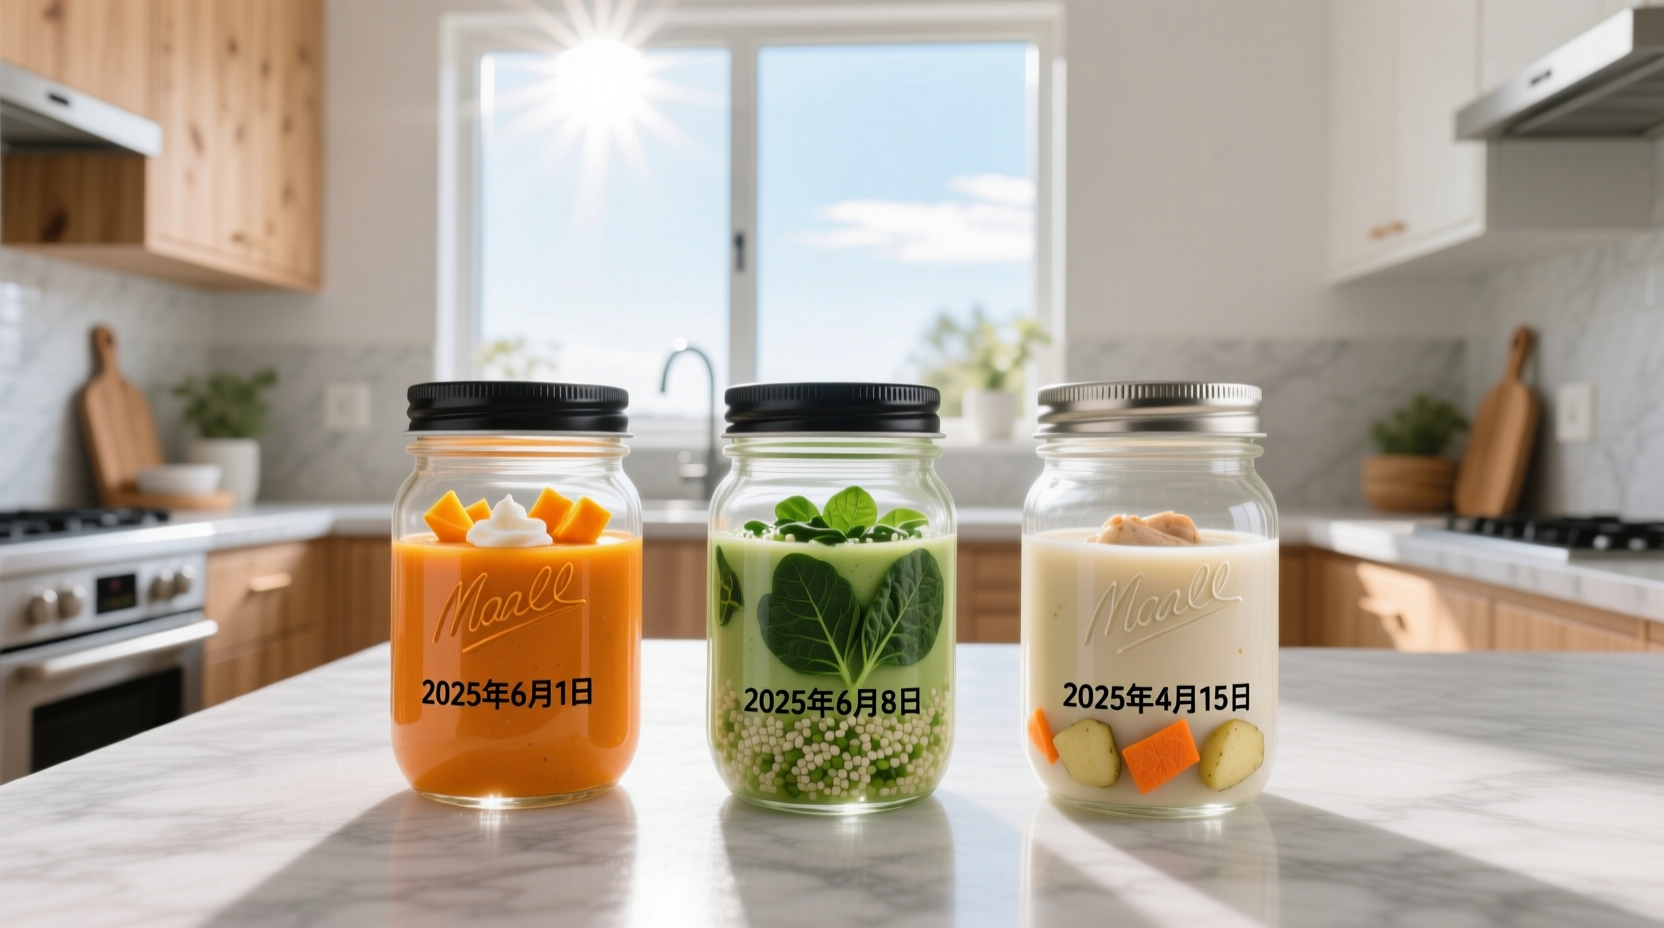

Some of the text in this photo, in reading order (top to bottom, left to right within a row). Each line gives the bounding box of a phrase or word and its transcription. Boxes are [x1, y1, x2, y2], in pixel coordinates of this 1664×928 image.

[421, 677, 592, 710] 2025年6月1日
[743, 687, 921, 718] 2025年6月8日
[1063, 682, 1250, 714] 2025年4月15日
